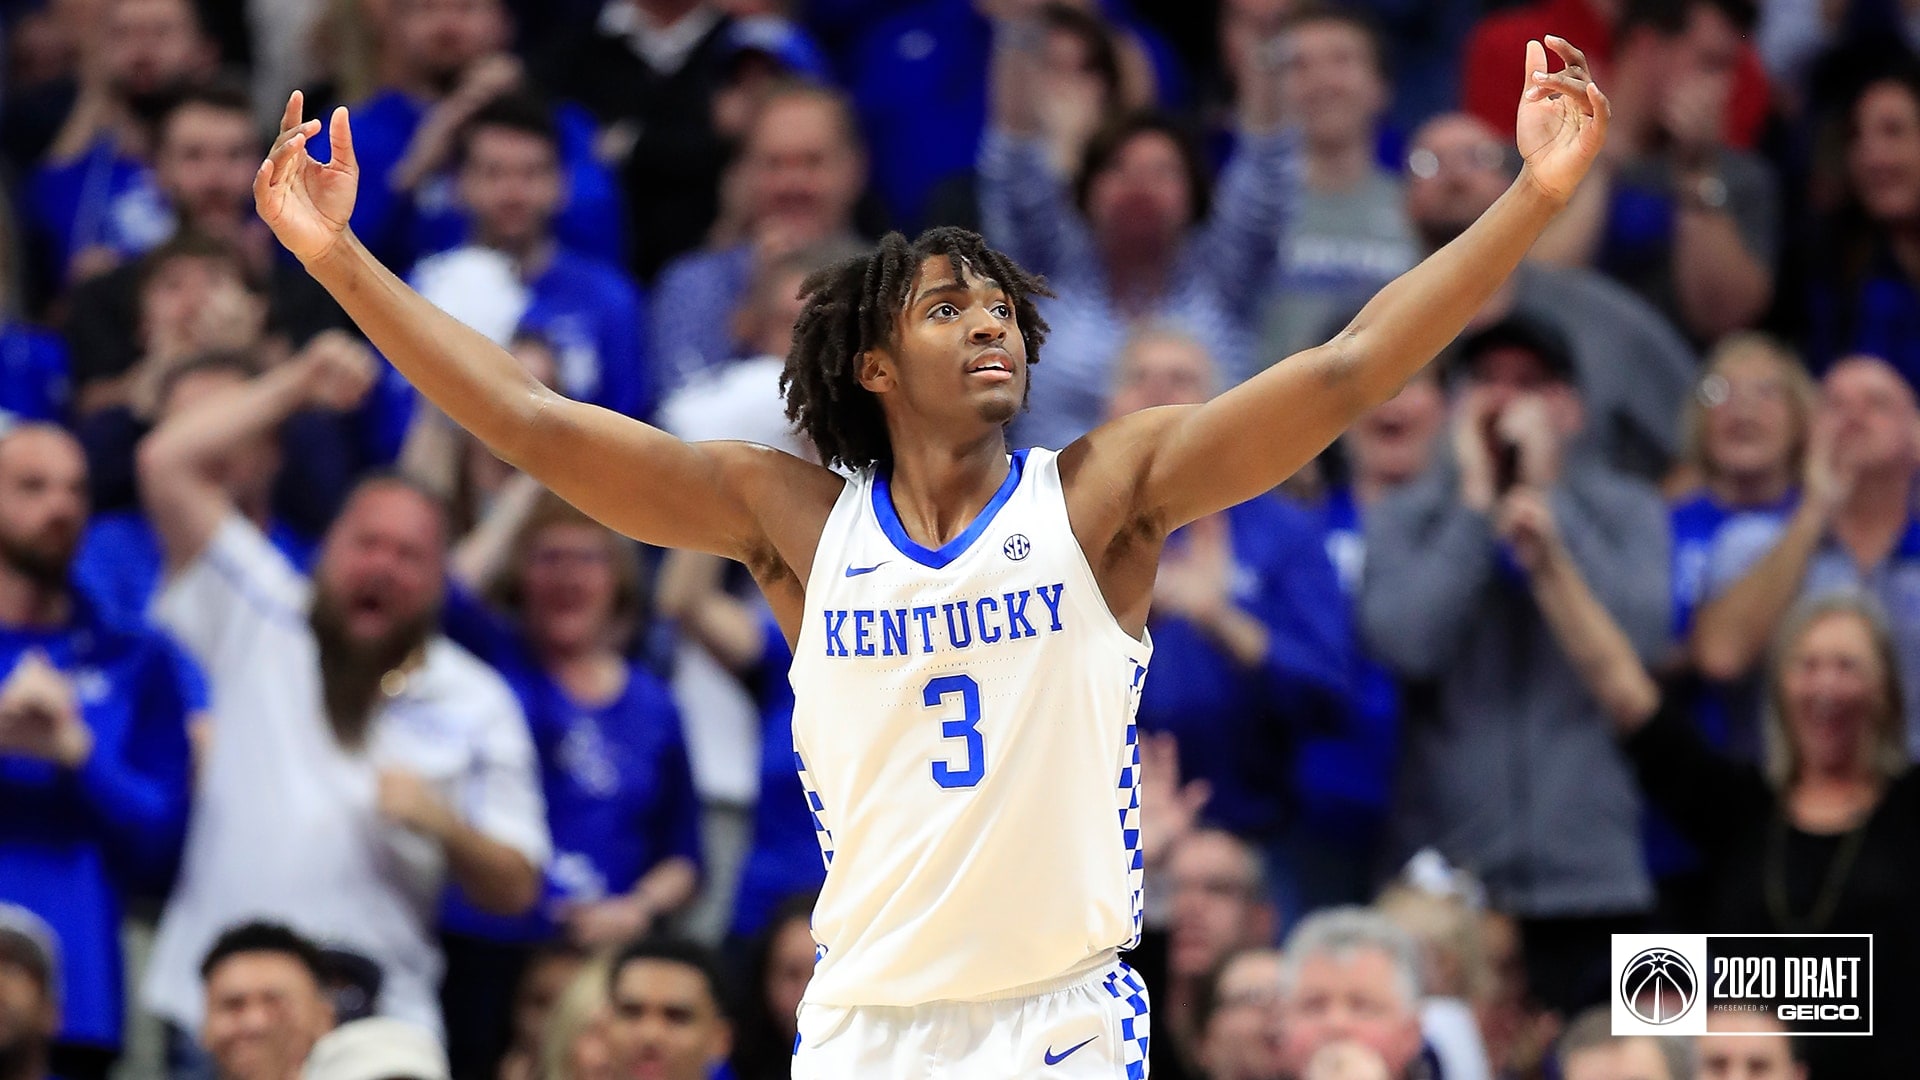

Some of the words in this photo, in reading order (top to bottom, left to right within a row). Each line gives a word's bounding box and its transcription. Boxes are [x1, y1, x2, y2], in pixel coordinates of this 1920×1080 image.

[1004, 534, 1030, 560] SEC
[824, 583, 1064, 657] KENTUCKY
[922, 674, 986, 789] 3
